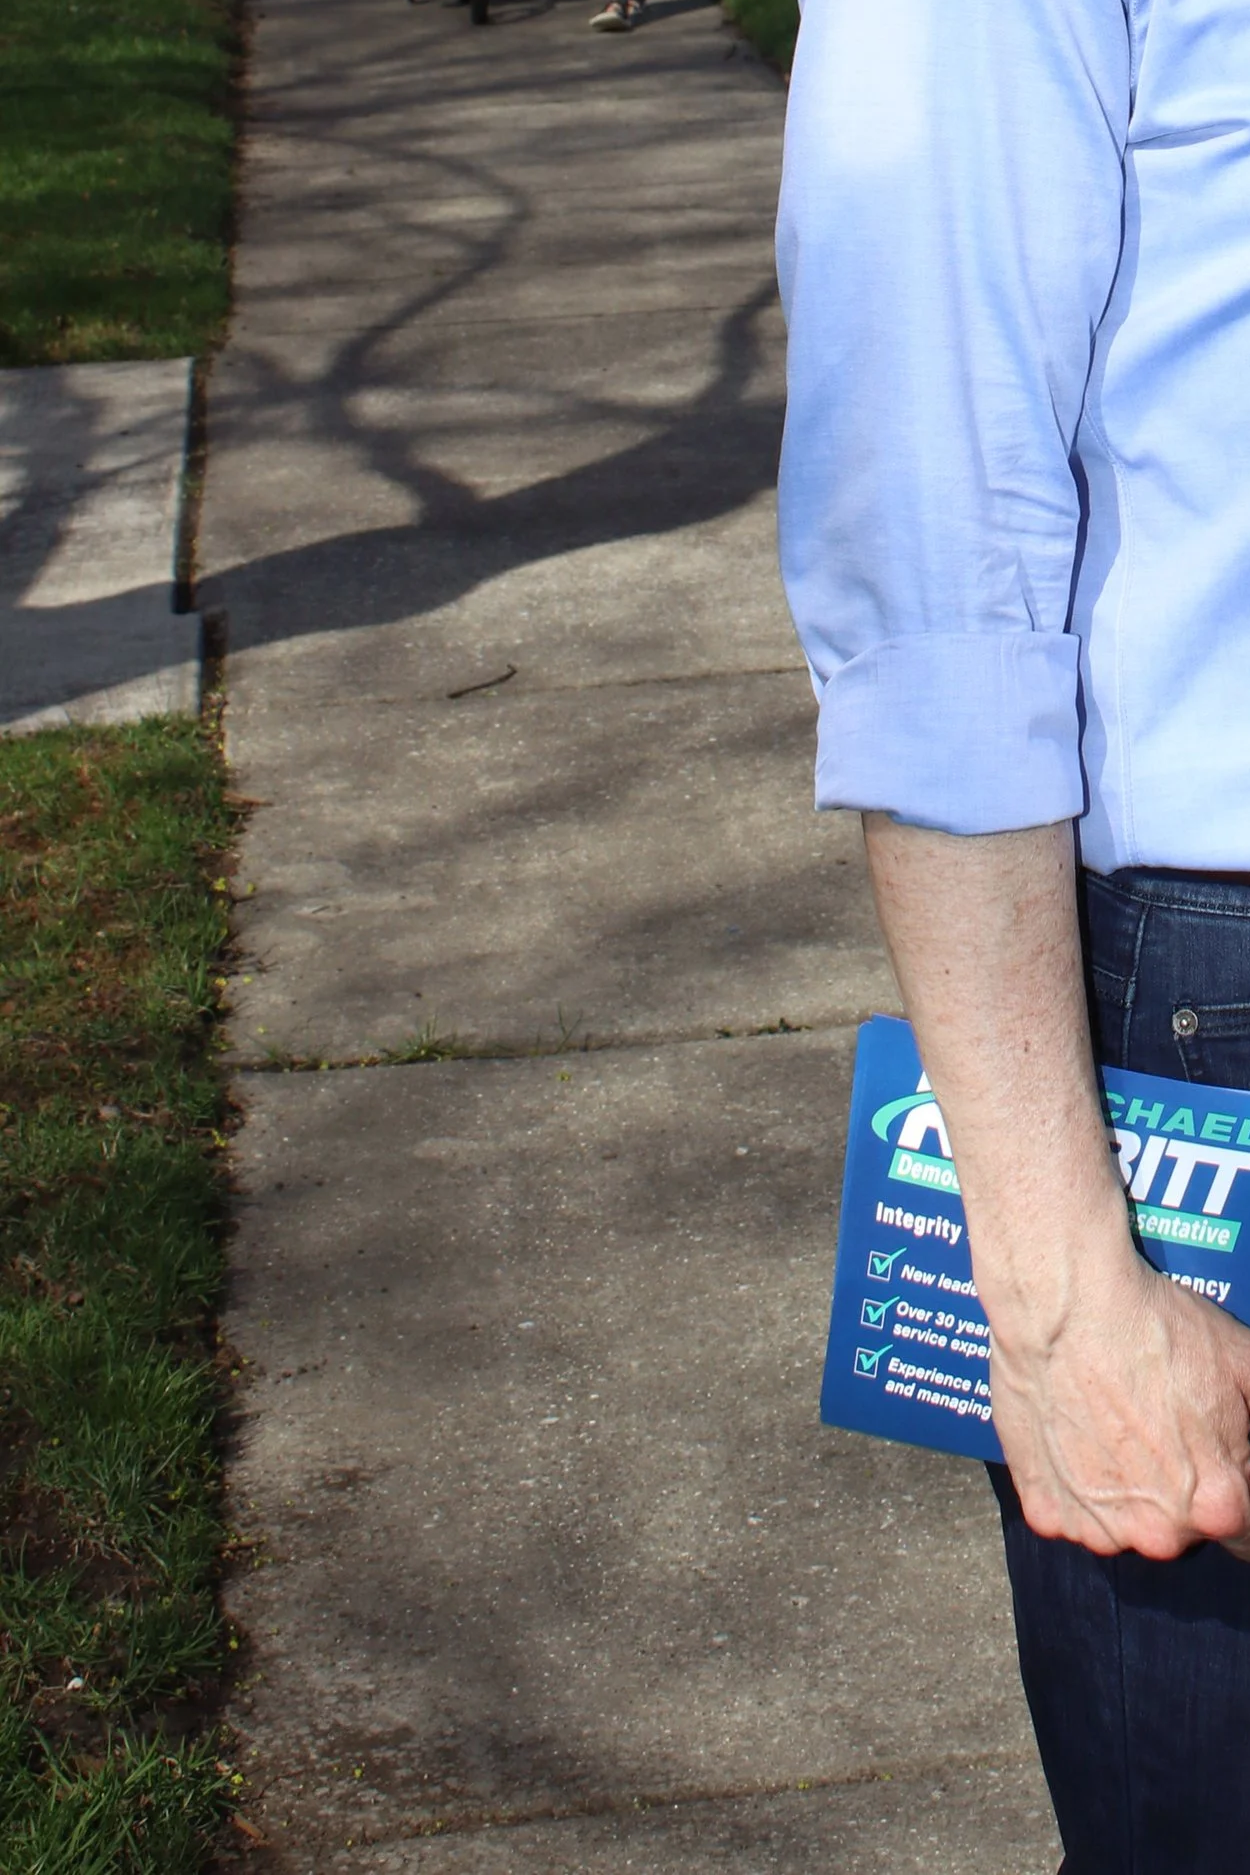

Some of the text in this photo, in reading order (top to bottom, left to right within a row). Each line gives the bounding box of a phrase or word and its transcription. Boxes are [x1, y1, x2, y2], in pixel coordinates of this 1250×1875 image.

[1130, 1211, 1231, 1246] sentative
[876, 1201, 1231, 1304] Integrity rency
[901, 1264, 937, 1286] New
[896, 1301, 933, 1323] Over
[935, 1310, 955, 1328] 30
[893, 1322, 948, 1348] service
[887, 1356, 972, 1392] Experience
[885, 1379, 993, 1421] and managing
